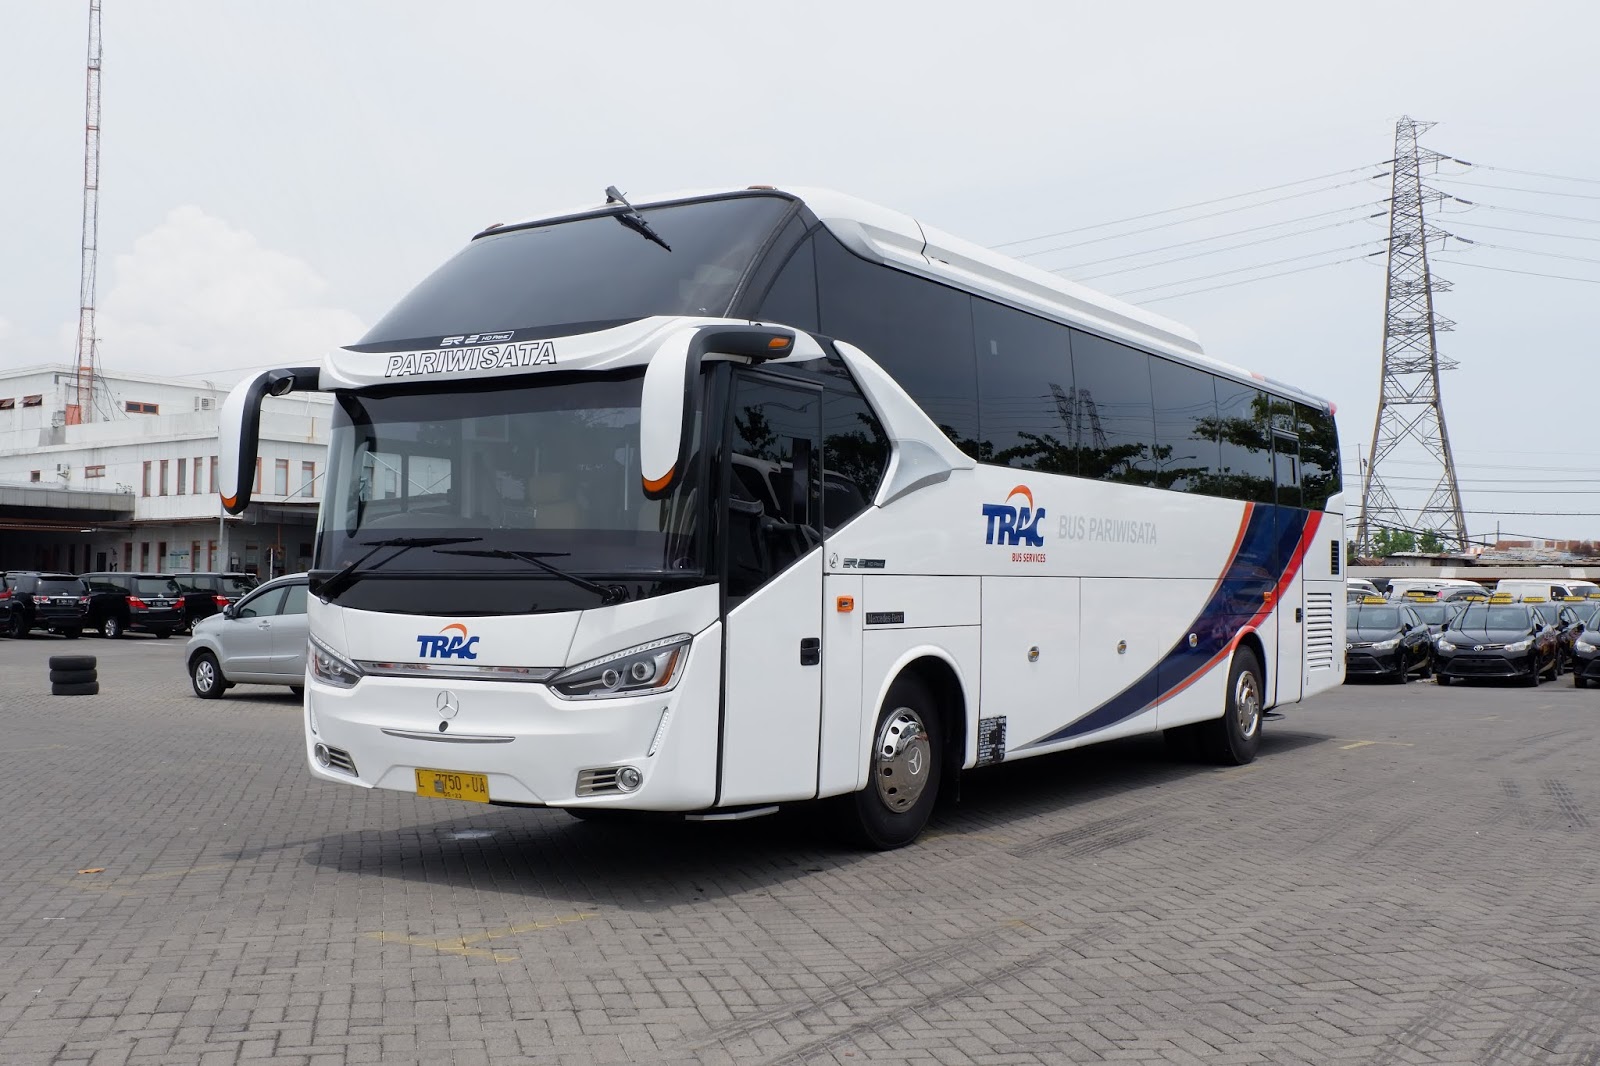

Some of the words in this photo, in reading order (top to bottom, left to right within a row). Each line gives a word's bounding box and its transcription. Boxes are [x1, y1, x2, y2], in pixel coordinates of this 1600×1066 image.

[384, 342, 557, 377] PARIWISATA
[981, 503, 1046, 547] TRAC
[1058, 514, 1085, 540] BUS
[1088, 517, 1157, 545] PARIWISATA
[1011, 552, 1022, 562] BUS
[1023, 552, 1046, 563] SERVICES
[867, 613, 904, 624] Mercedes-Benz
[416, 635, 480, 659] TRAC
[416, 772, 425, 788] L
[471, 776, 486, 794] UA
